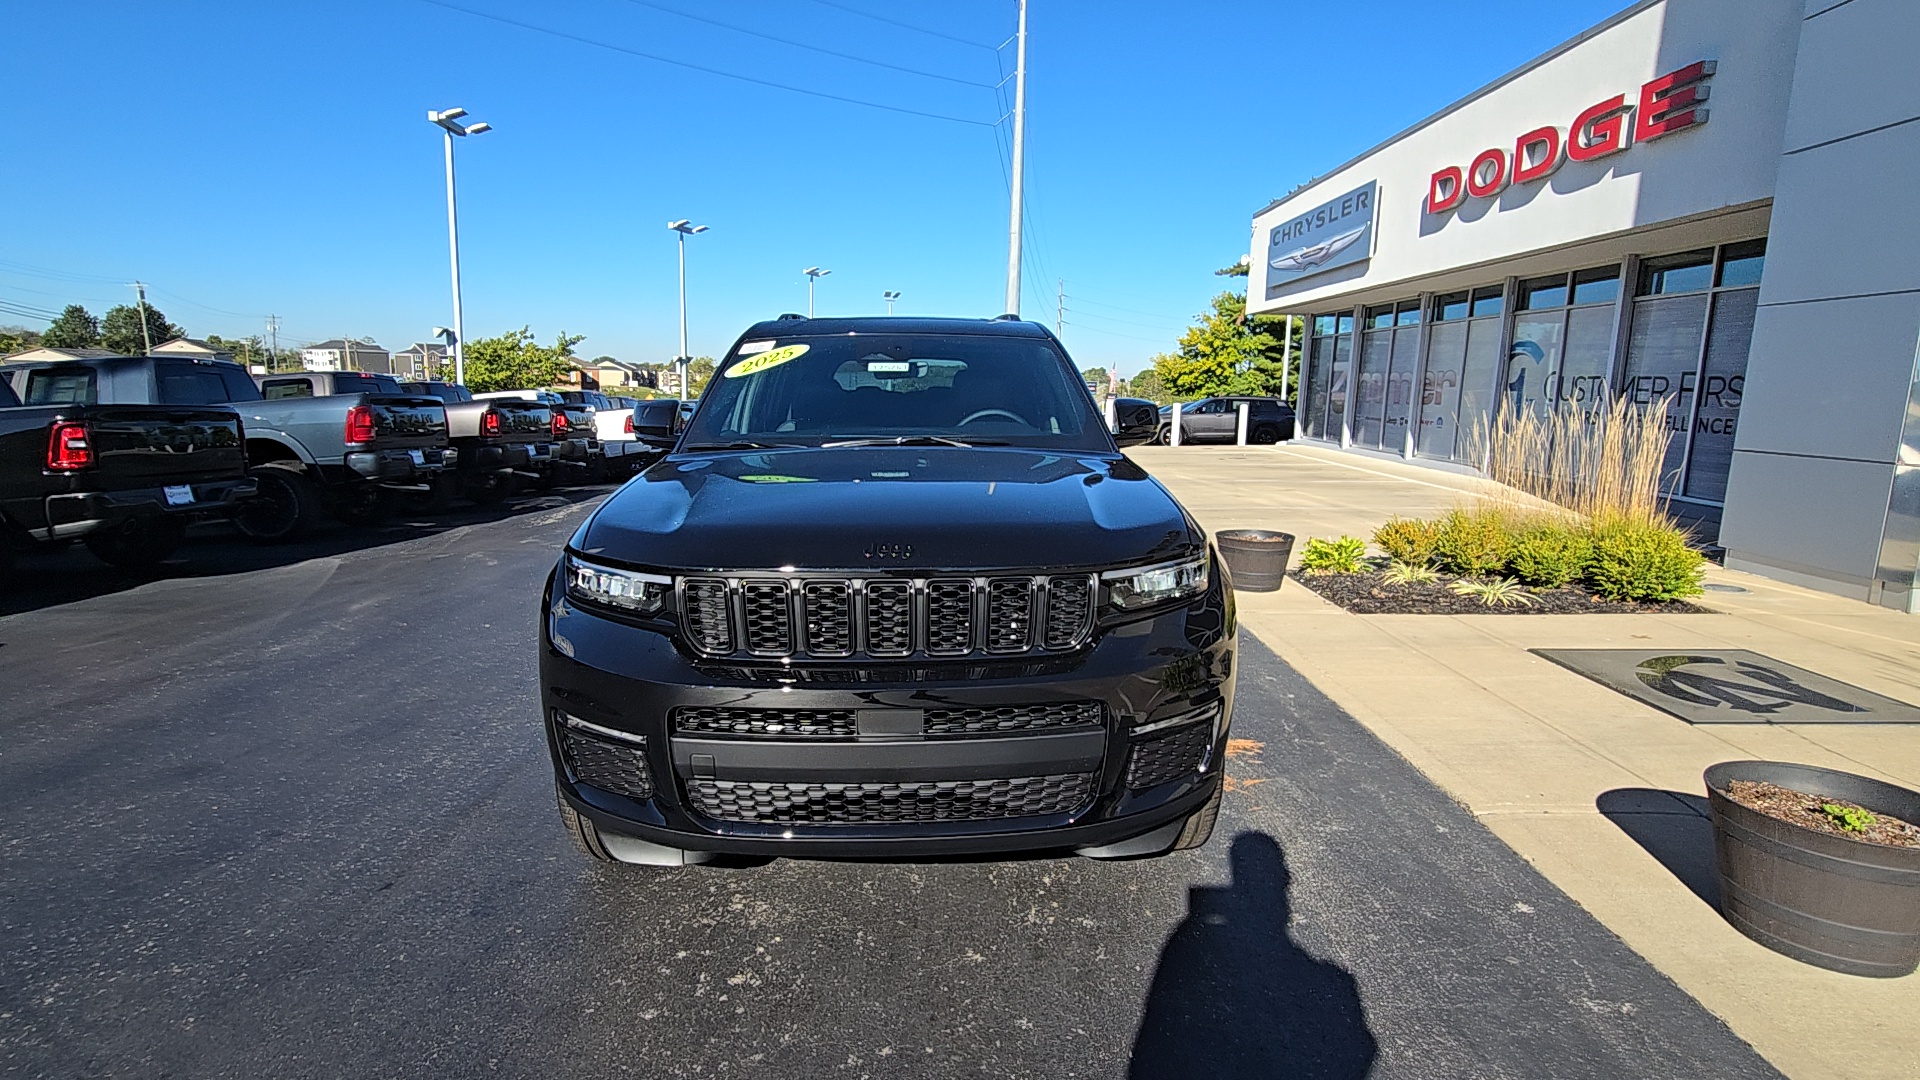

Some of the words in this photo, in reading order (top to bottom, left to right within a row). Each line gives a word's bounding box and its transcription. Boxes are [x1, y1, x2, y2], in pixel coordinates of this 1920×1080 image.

[1427, 60, 1717, 214] DODGE
[1272, 190, 1369, 247] CHRYSLER
[742, 347, 793, 374] 2025
[863, 542, 913, 560] Jeep
